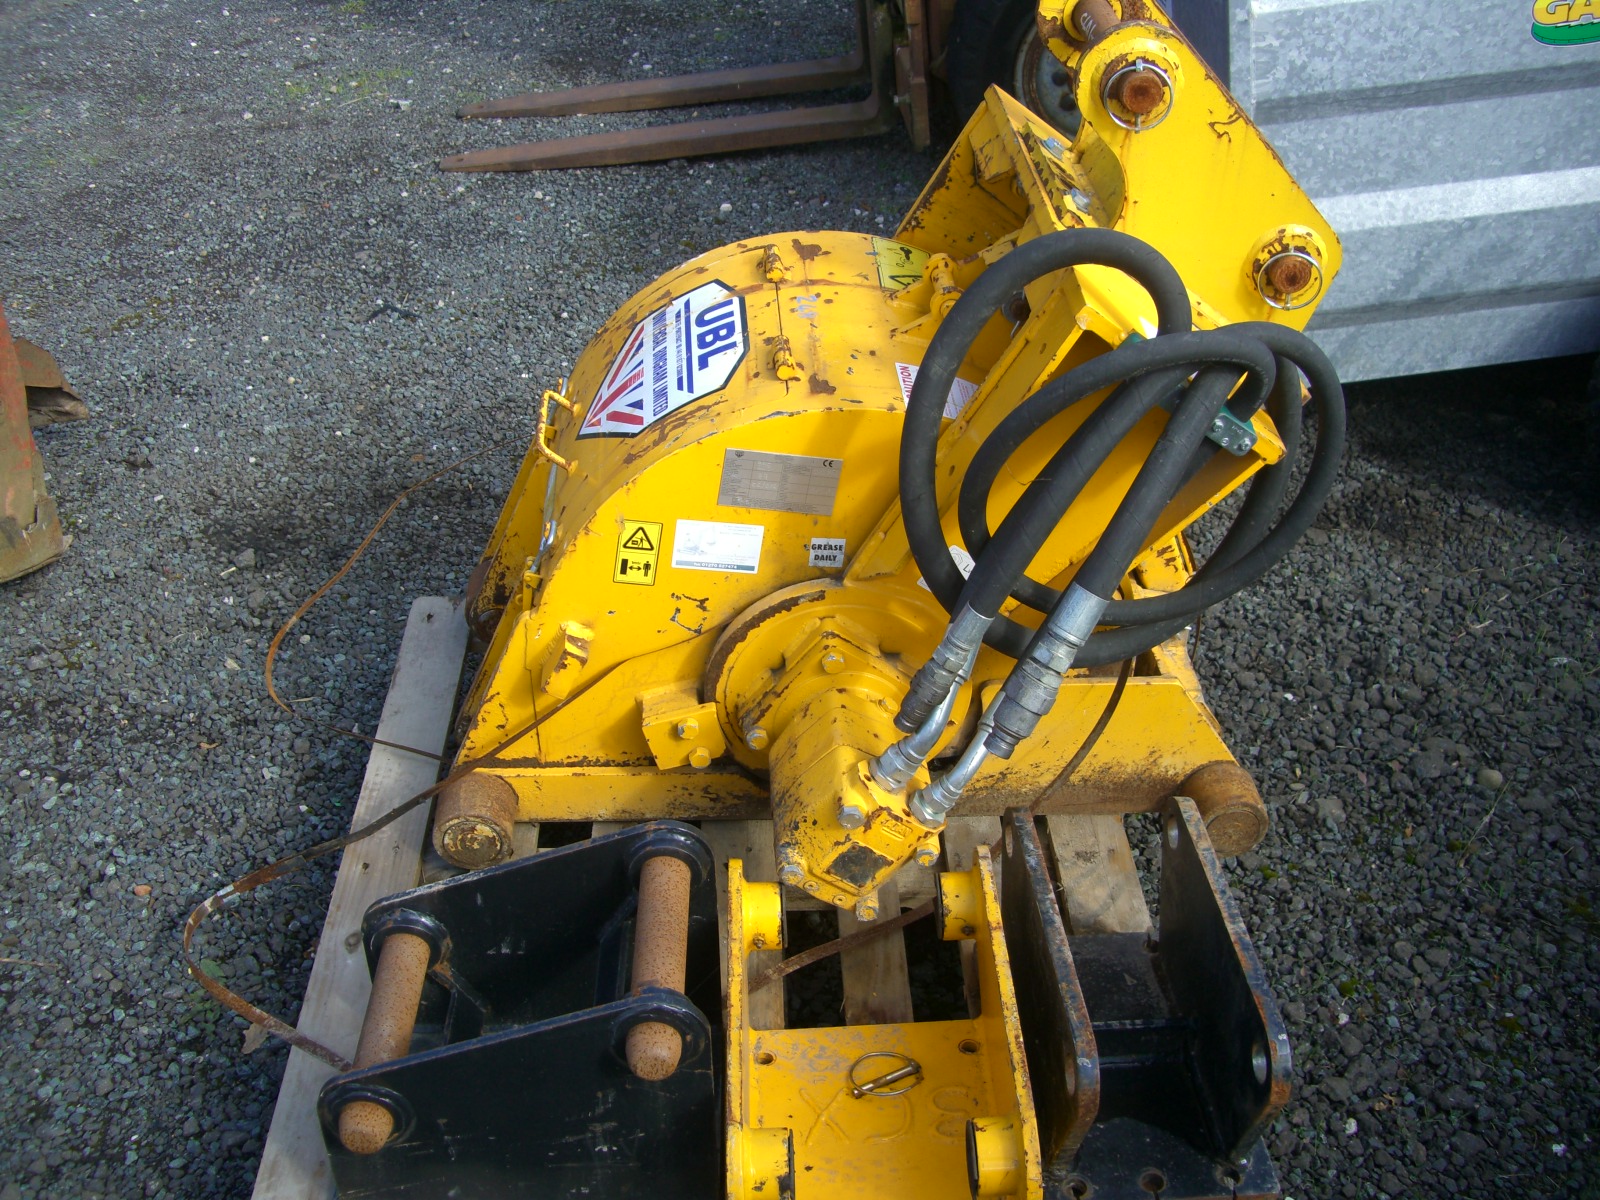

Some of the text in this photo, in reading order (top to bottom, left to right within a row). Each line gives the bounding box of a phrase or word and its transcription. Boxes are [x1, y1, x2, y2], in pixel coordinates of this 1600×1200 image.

[694, 298, 737, 371] UBL
[652, 308, 669, 417] UNIVERSAL BINGHAM LIMITED
[822, 459, 834, 468] CE
[811, 543, 844, 552] GREASE
[813, 554, 838, 562] DAILY
